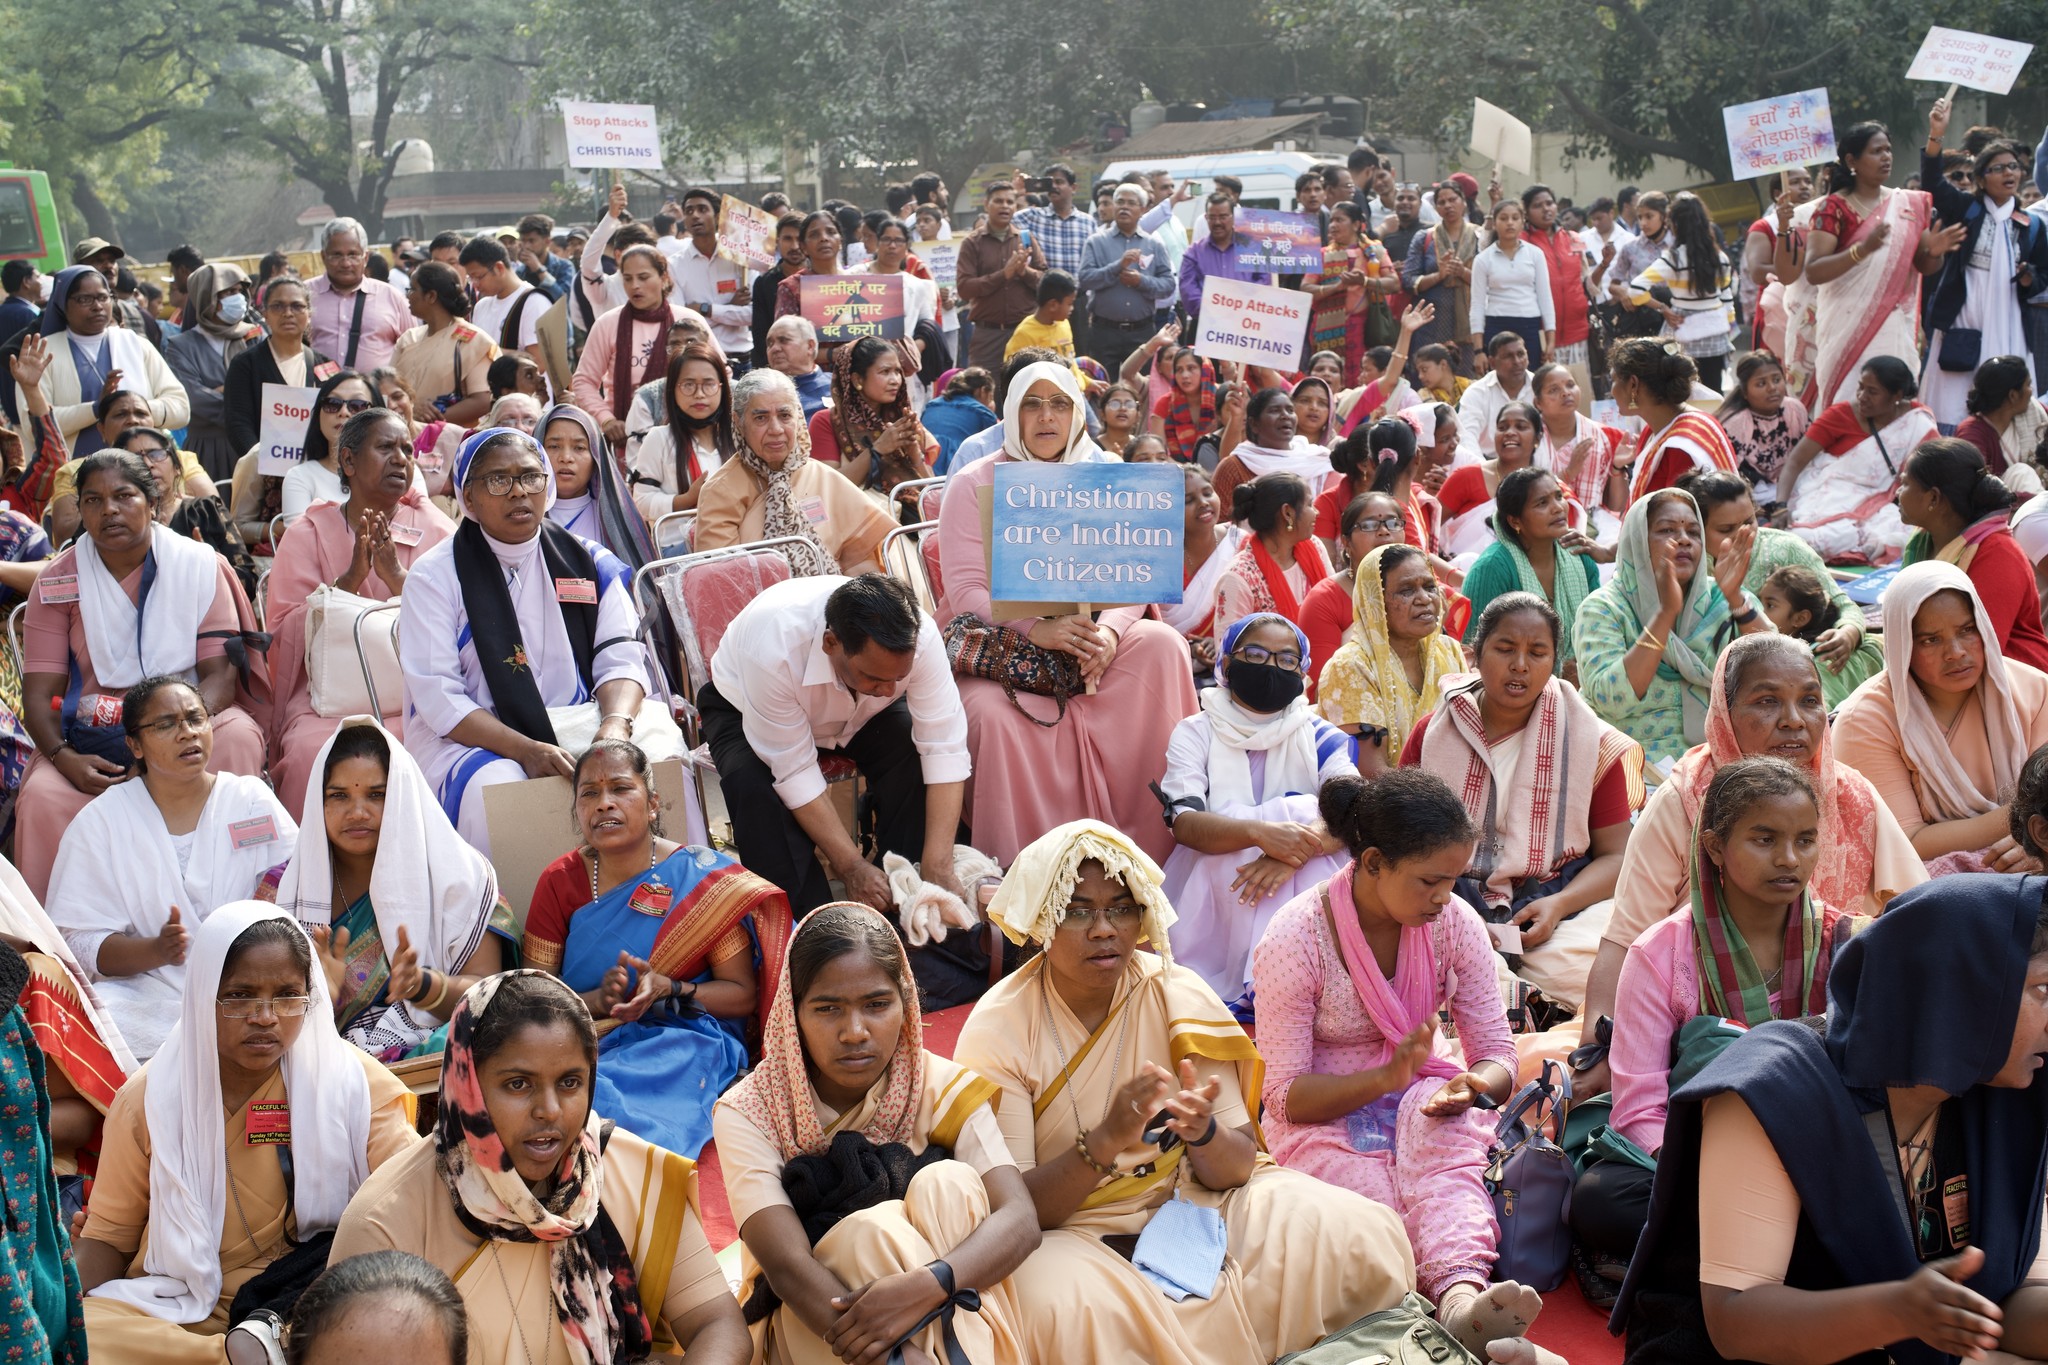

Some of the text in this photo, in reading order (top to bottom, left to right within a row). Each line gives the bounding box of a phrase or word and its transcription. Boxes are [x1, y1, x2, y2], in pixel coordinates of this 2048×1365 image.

[573, 115, 649, 128] Stop Attacks
[604, 131, 622, 141] On
[577, 145, 653, 158] CHRISTIANS
[1262, 237, 1273, 249] के
[1239, 252, 1267, 265] आरोप
[1269, 255, 1296, 266] वापस
[818, 280, 887, 296] मसीहों पर
[823, 303, 884, 316] अत्याचार
[1211, 293, 1300, 319] Stop Attacks
[822, 322, 841, 337] बंद
[1242, 317, 1261, 331] On
[1206, 330, 1293, 355] CHRISTIANS
[273, 402, 310, 421] Stop
[1005, 482, 1174, 511] Christians
[1003, 521, 1174, 547] are Indian
[1022, 555, 1153, 584] Citizens
